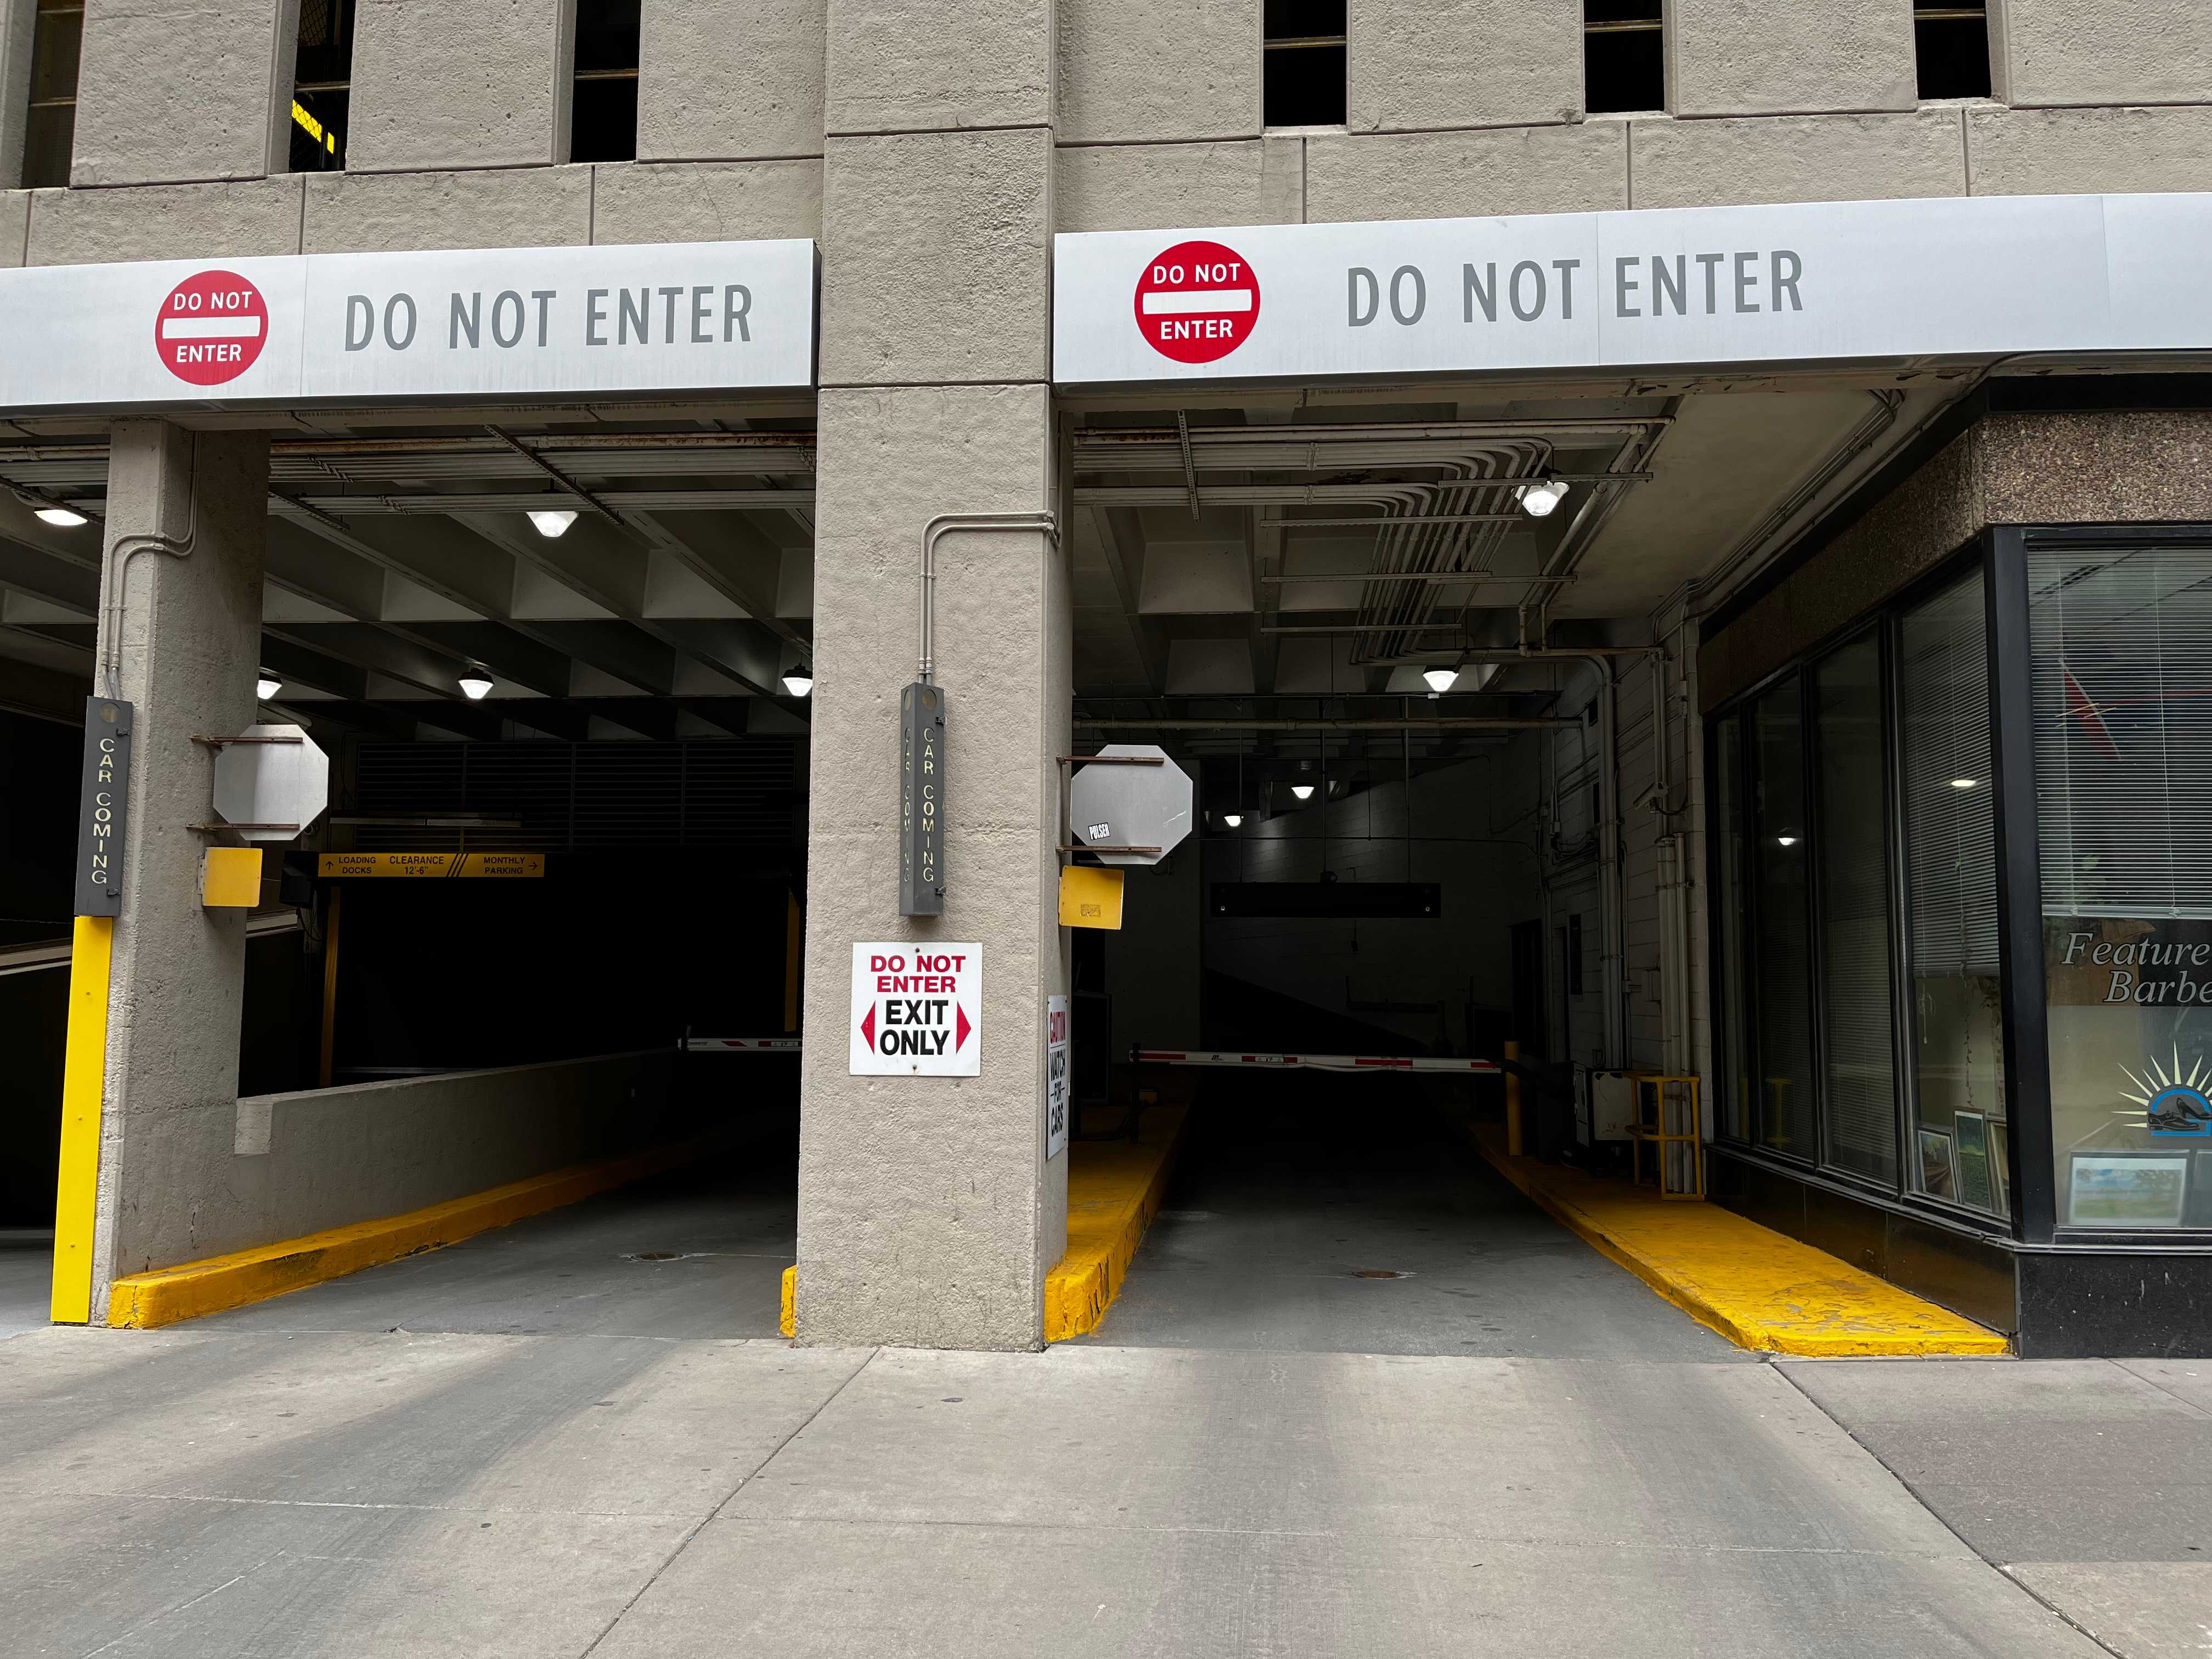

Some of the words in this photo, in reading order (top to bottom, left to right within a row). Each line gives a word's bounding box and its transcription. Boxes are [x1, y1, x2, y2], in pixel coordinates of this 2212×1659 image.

[1154, 265, 1184, 284] DO
[1195, 263, 1240, 283] NOT
[174, 293, 201, 311] DO
[211, 291, 252, 309] NOT
[1348, 265, 1426, 326] DO
[1463, 259, 1580, 323] NOT
[1616, 250, 1803, 318] ENTER
[345, 292, 417, 352] DO
[449, 290, 556, 349] NOT
[585, 284, 752, 346] ENTER
[1160, 319, 1233, 340] ENTER
[176, 344, 241, 363] ENTER
[98, 738, 114, 783] CAR
[923, 727, 934, 775] CAR
[92, 792, 111, 884] COMING
[922, 785, 934, 882] COMING
[1089, 823, 1109, 839] PULSER
[390, 856, 444, 865] CLEARANCE
[2060, 932, 2211, 966] Feature
[871, 955, 905, 972] DO
[916, 956, 966, 972] NOT
[877, 976, 956, 992] ENTER
[885, 1000, 949, 1025] EXIT
[879, 1029, 950, 1056] ONLY
[1051, 1049, 1065, 1081] WATCH
[1051, 1103, 1063, 1136] CARS
